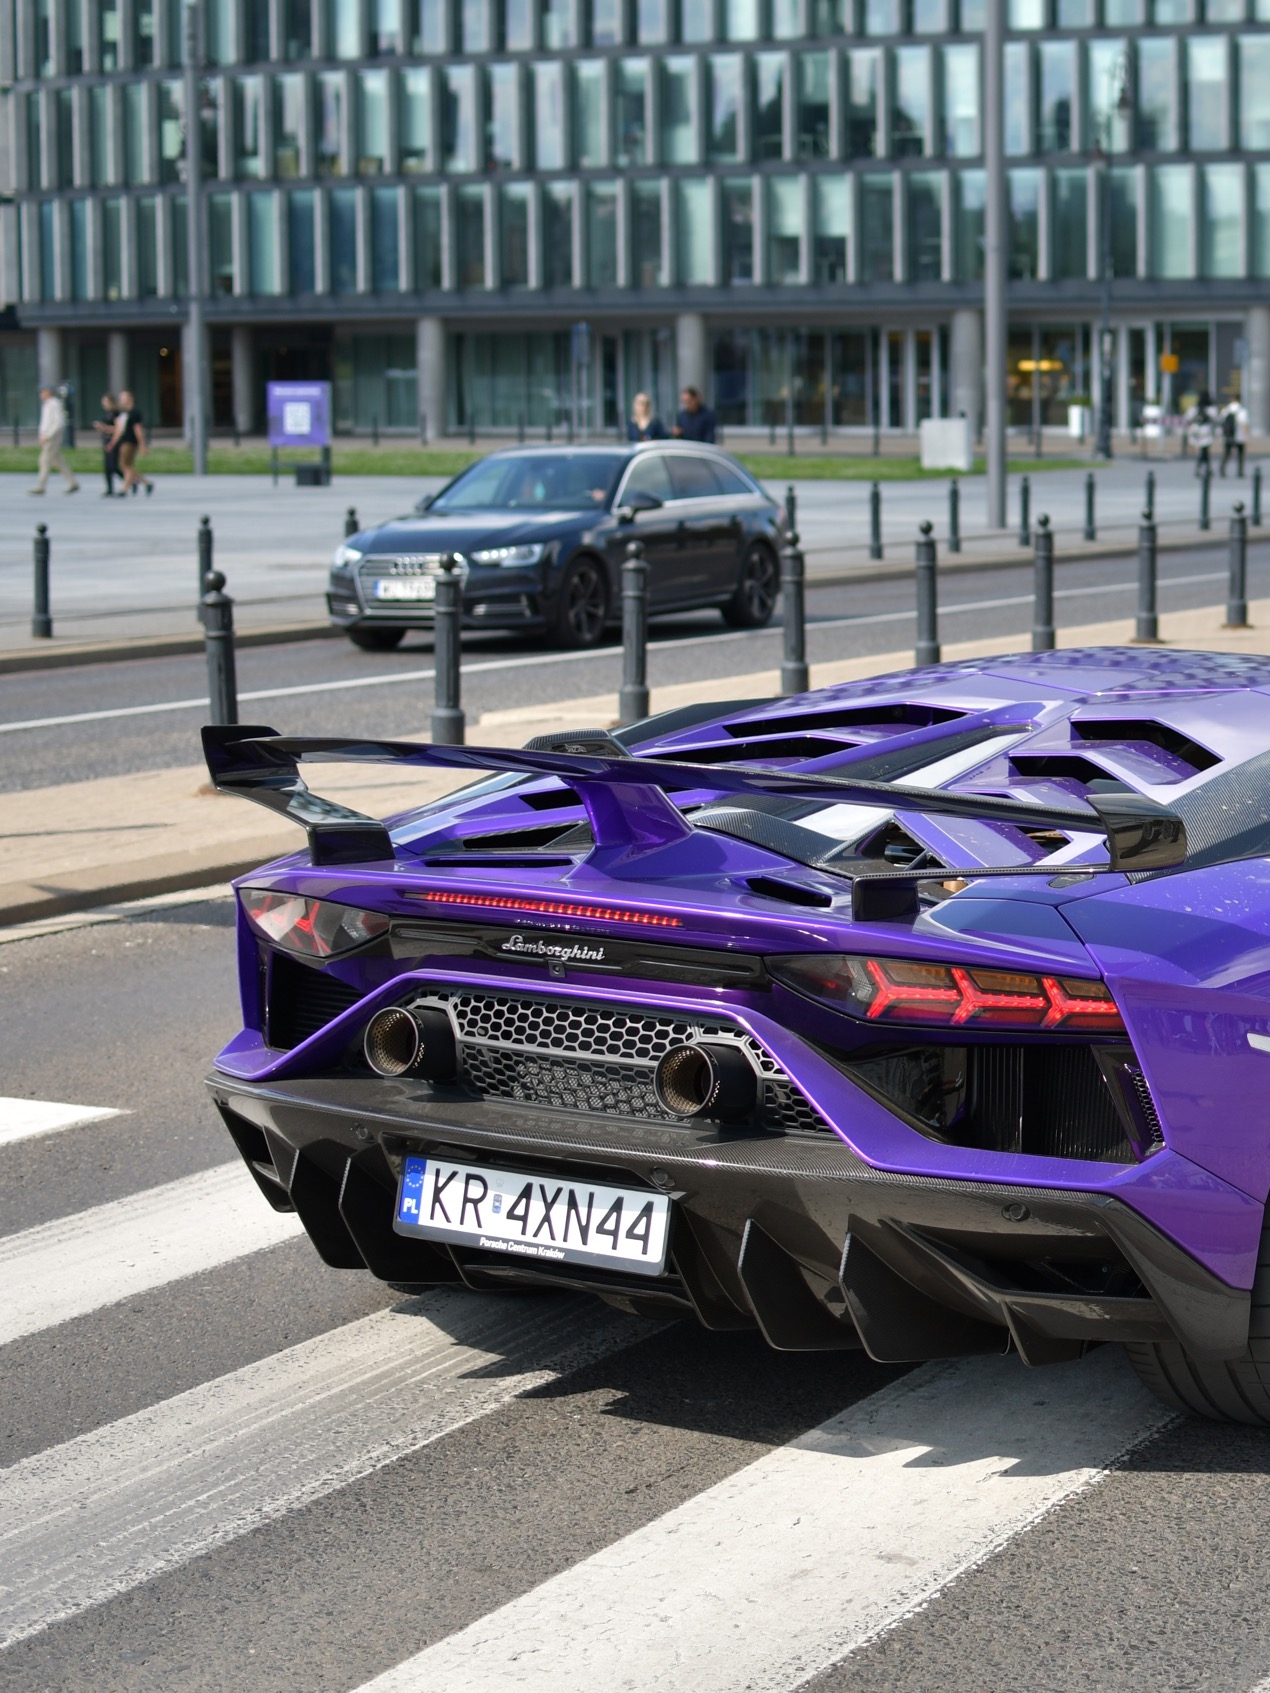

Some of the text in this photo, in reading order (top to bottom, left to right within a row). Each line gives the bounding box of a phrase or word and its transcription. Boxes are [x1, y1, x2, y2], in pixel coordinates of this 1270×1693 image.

[501, 934, 605, 961] Lamborghini
[402, 1197, 419, 1215] PL
[429, 1167, 655, 1256] KR 4XN44
[480, 1236, 508, 1250] Porsche
[507, 1241, 538, 1255] Centrum
